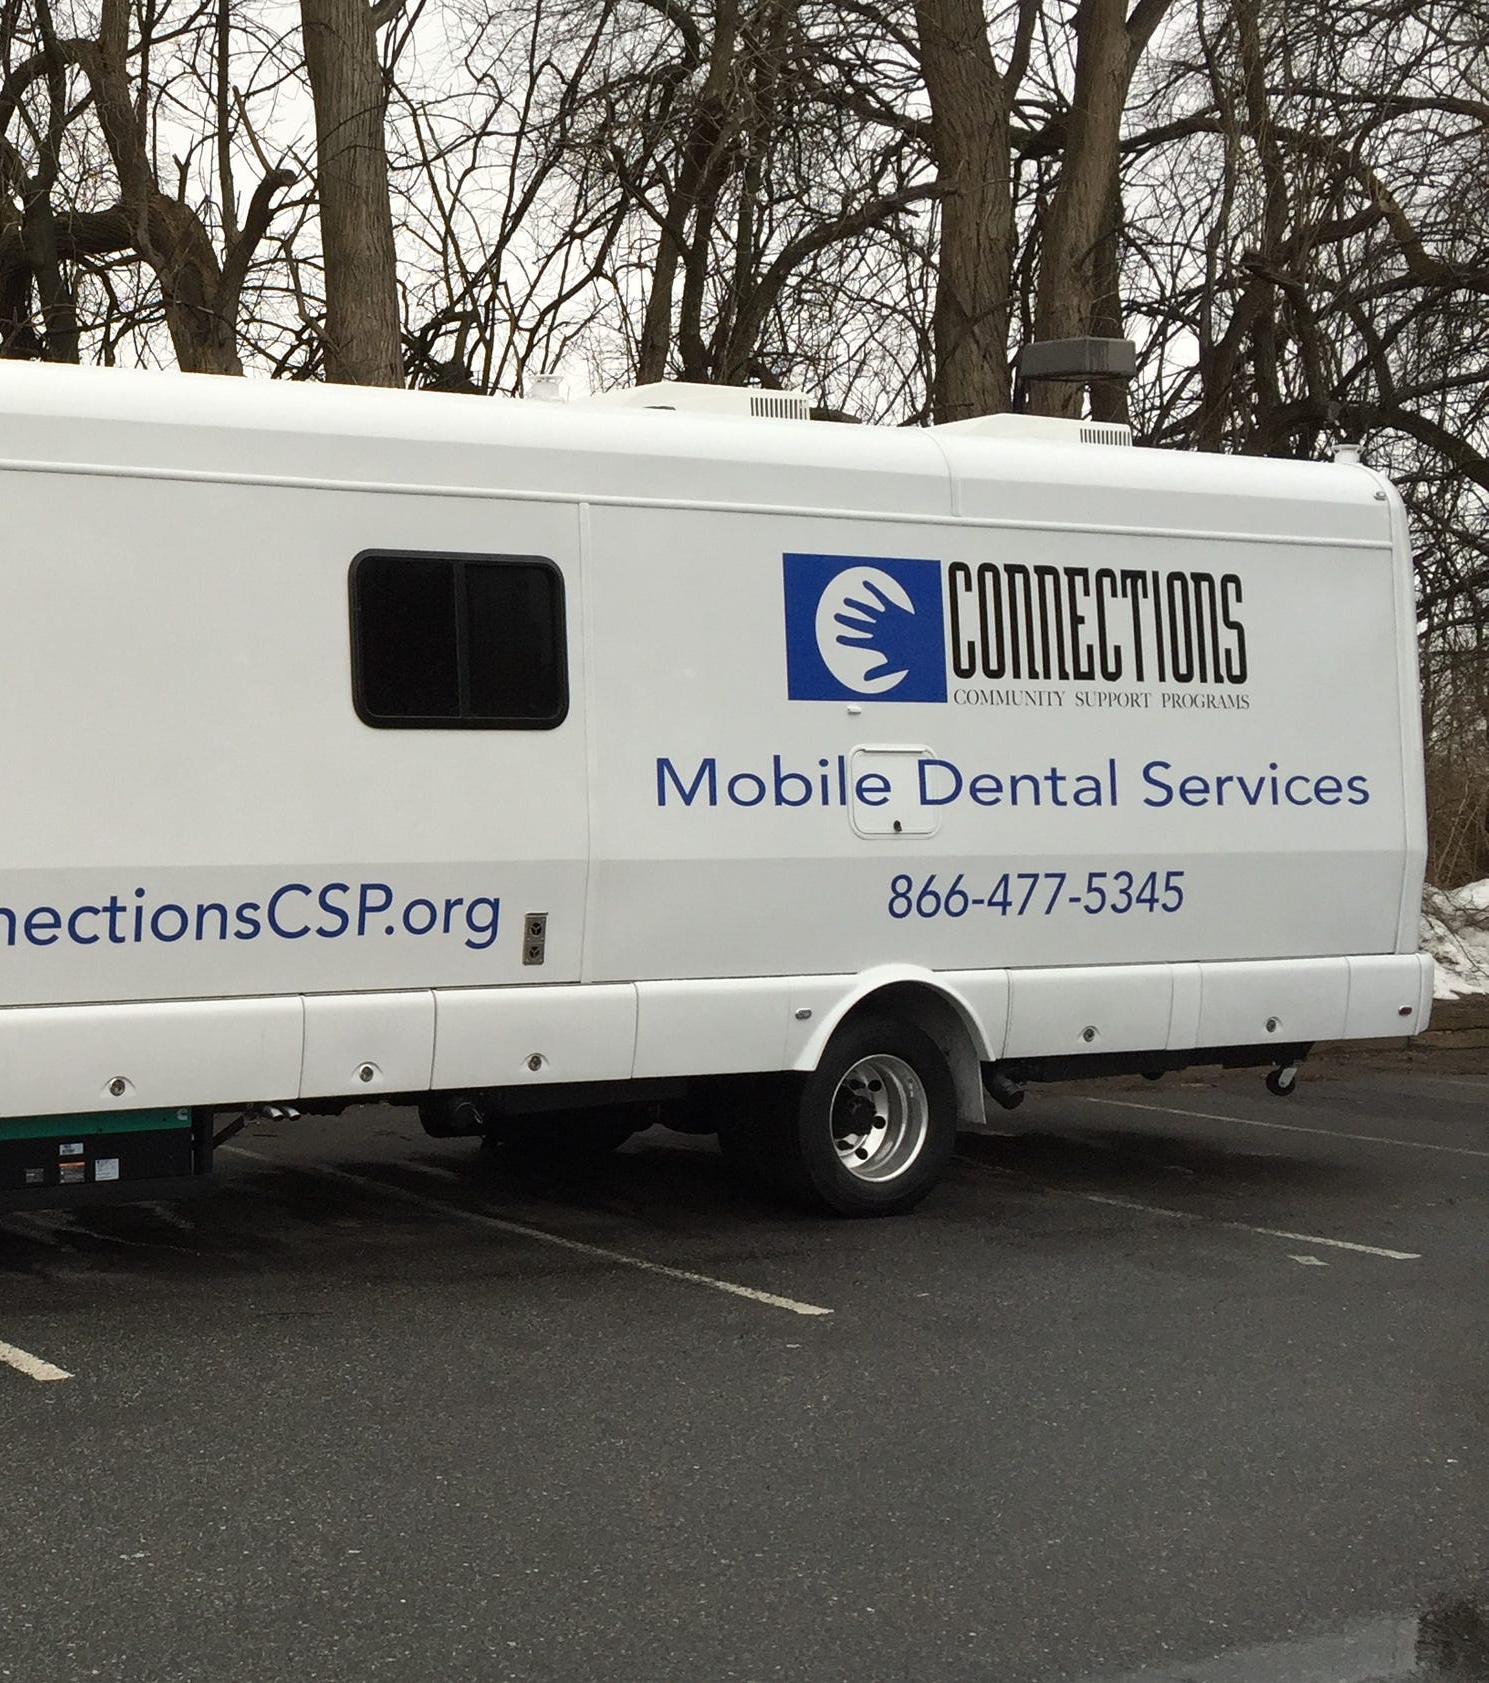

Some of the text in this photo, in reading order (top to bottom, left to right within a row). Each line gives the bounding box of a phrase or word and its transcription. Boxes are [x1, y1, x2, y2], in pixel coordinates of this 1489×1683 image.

[948, 561, 1248, 684] CONNECTIONS
[953, 689, 1250, 709] COMMUNITY SUPPORT PROGRAMS
[656, 755, 1370, 807] Mobile Dental Services
[888, 871, 1185, 919] 866-477-5345
